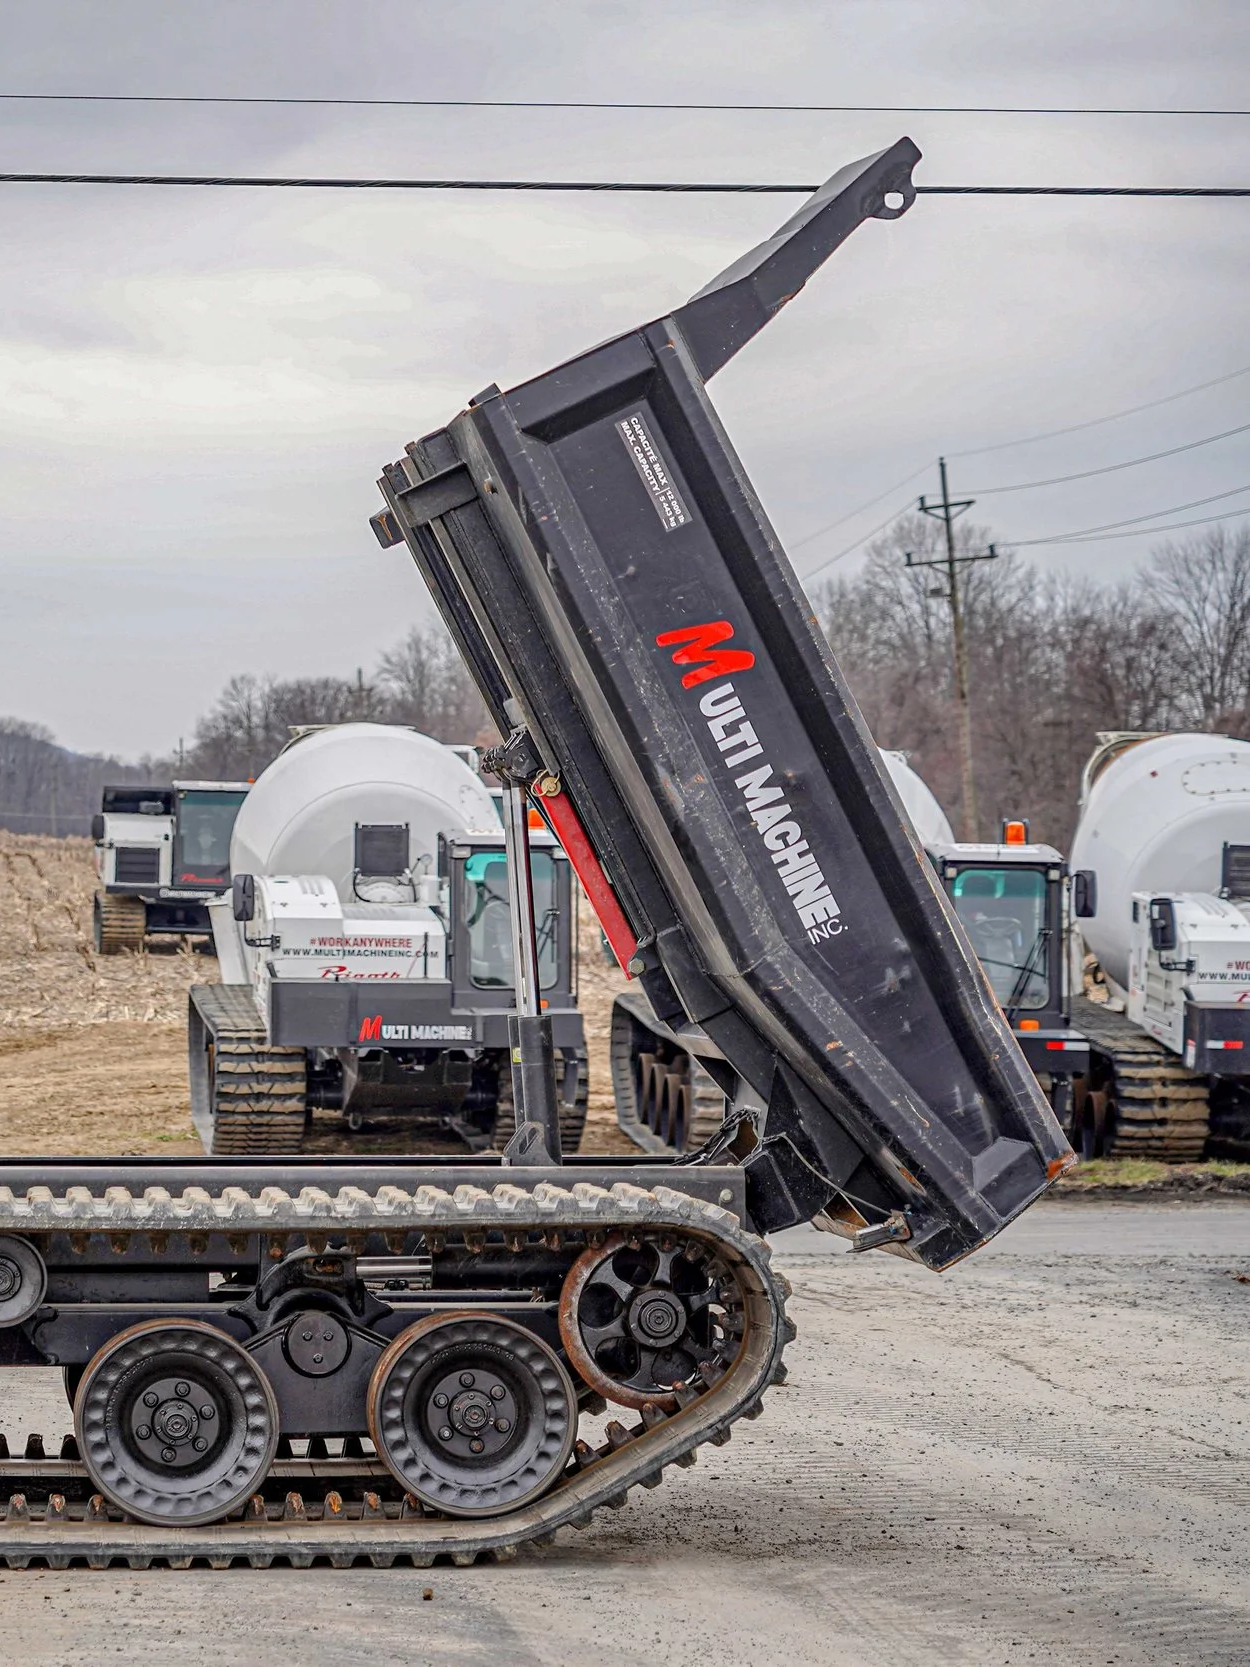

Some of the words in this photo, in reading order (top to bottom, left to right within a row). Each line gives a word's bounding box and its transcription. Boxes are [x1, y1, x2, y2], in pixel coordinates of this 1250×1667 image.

[620, 421, 637, 446] MAX.
[633, 446, 661, 492] CAPACITY
[662, 502, 673, 517] 443
[669, 517, 677, 527] kg
[631, 417, 658, 463] CAPACITÉ
[653, 463, 669, 486] MAX
[666, 490, 675, 500] 12
[671, 500, 682, 515] 000
[656, 620, 764, 768] MULTI
[734, 763, 841, 930] MACHINE
[807, 918, 849, 945] INC.
[310, 937, 413, 949] #WORKANYWHERE
[358, 1014, 410, 1042] MULTI
[411, 1024, 466, 1040] MACHINE
